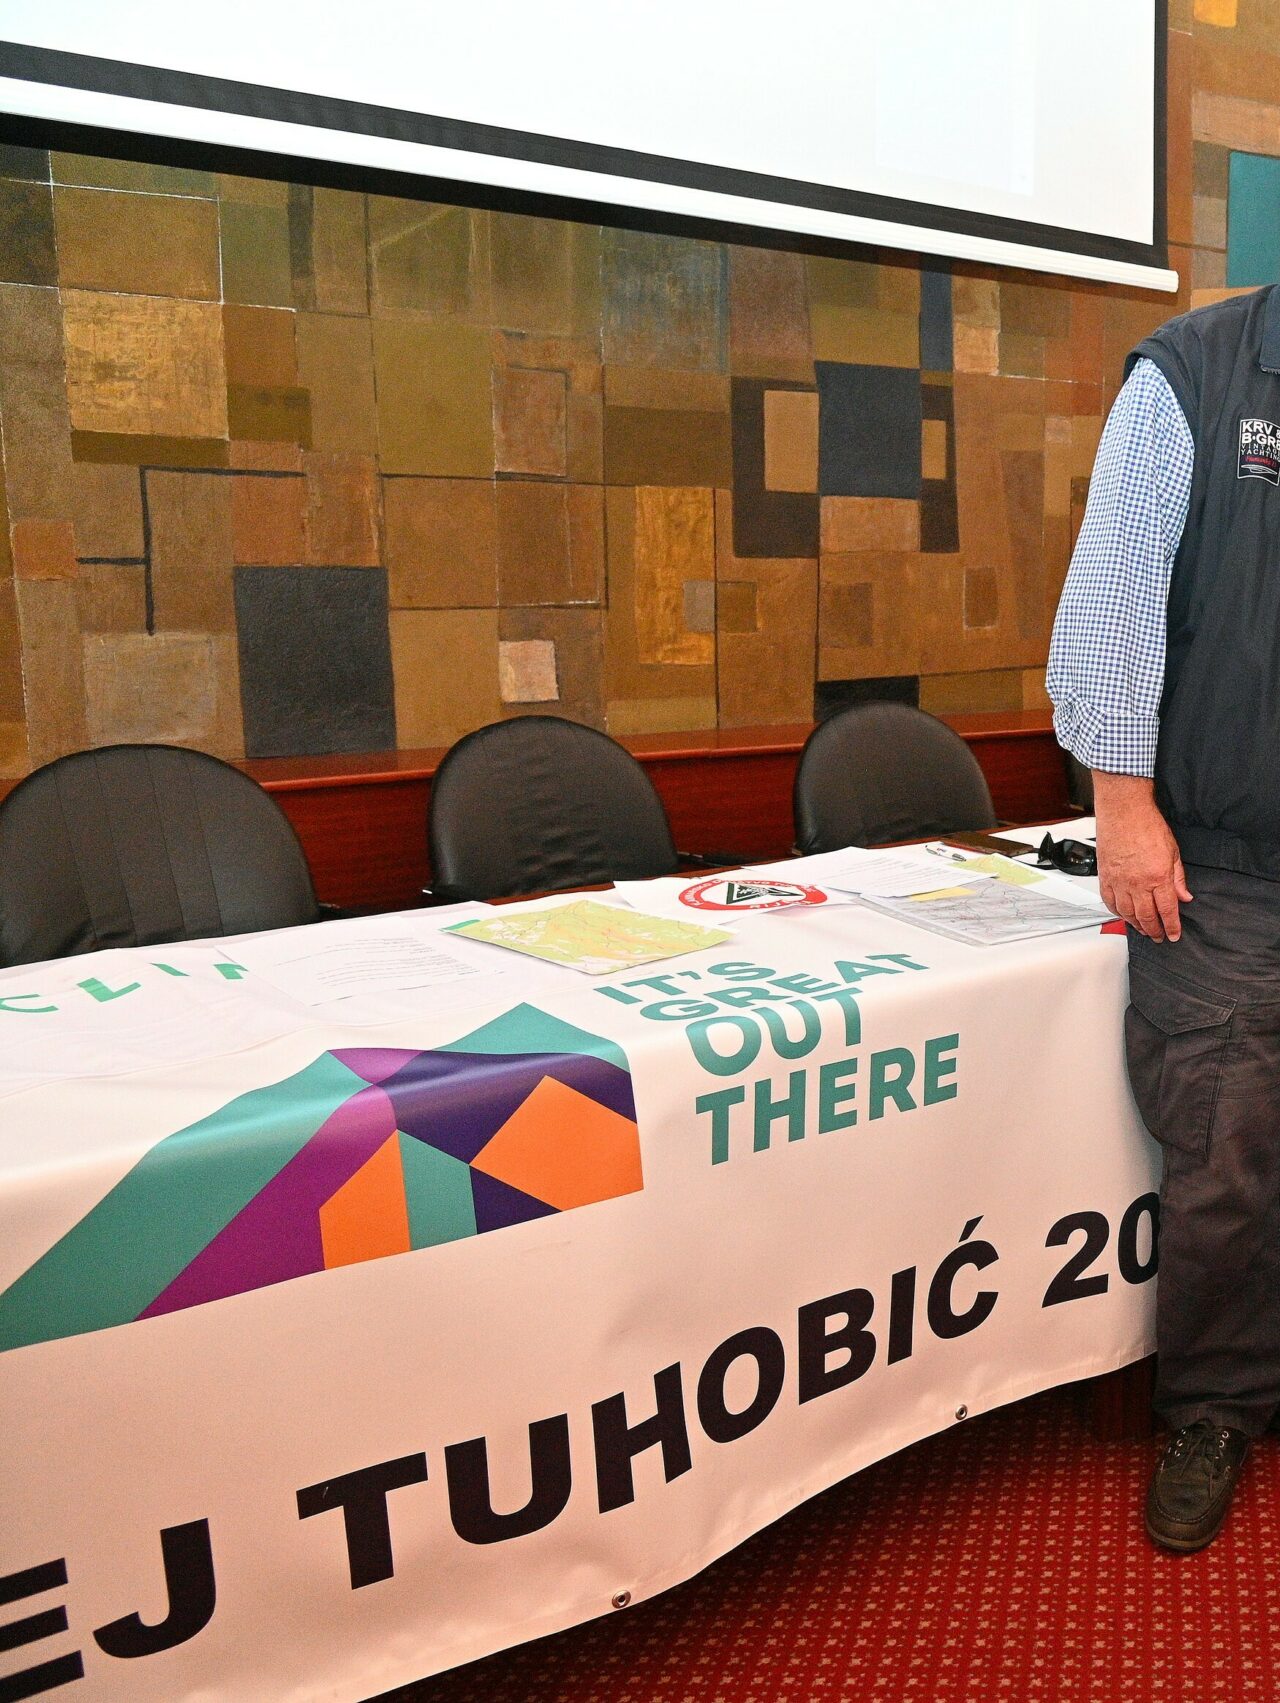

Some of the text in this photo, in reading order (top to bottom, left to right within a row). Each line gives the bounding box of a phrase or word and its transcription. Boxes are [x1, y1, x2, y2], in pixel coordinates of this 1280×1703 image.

[1241, 449, 1280, 463] YACHTING
[1242, 421, 1273, 435] KRV
[593, 962, 776, 1004] IT'S
[640, 954, 929, 1021] GREAT
[686, 988, 863, 1077] OUT
[696, 1033, 960, 1166] THERE
[295, 1215, 1000, 1591] TUHOBIĆ
